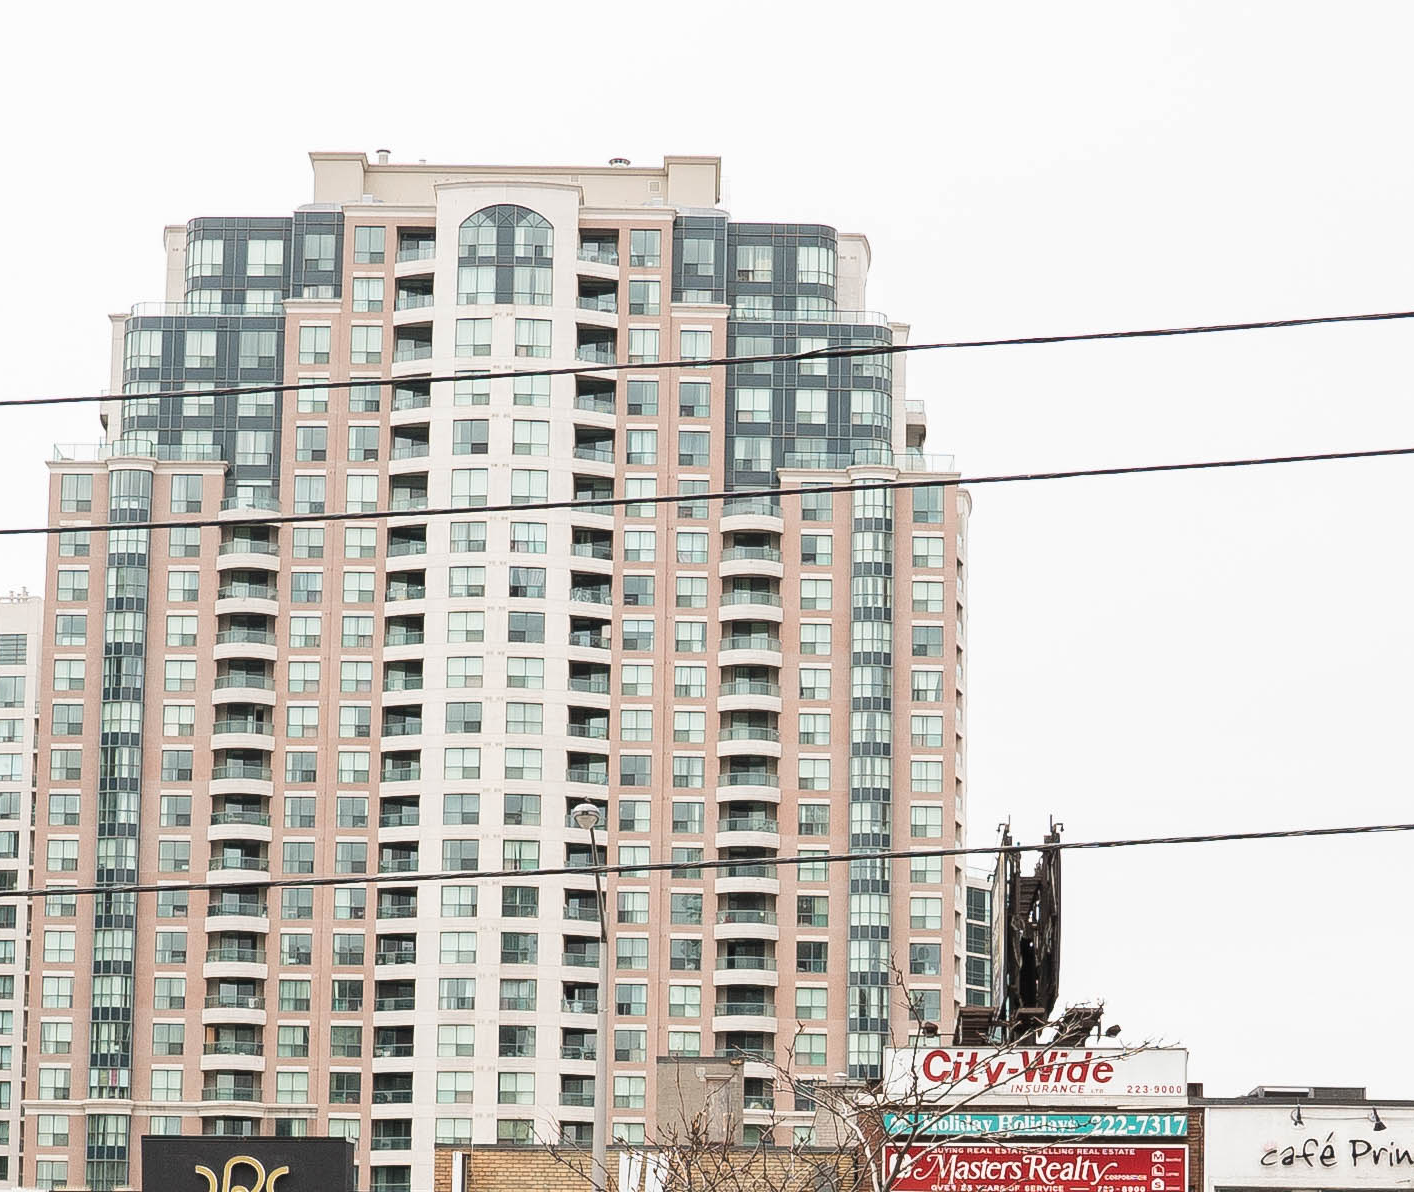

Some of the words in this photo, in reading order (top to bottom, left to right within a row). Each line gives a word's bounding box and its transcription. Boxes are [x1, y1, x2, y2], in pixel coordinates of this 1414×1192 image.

[922, 1050, 1114, 1087] City-Wide
[1010, 1084, 1084, 1094] INSURANCE
[1127, 1085, 1182, 1094] 223-9000
[997, 1115, 1079, 1136] Holidays
[1091, 1115, 1185, 1136] 222-7317
[966, 1147, 992, 1155] REAL
[994, 1147, 1029, 1155] ESTATE
[1035, 1148, 1068, 1156] SELLING
[1069, 1148, 1093, 1156] REAL
[1097, 1148, 1135, 1156] ESTATE
[1260, 1131, 1336, 1170] café
[914, 1154, 1022, 1186] Masters
[1022, 1154, 1118, 1188] Realty
[1024, 1185, 1064, 1192] SERVICE
